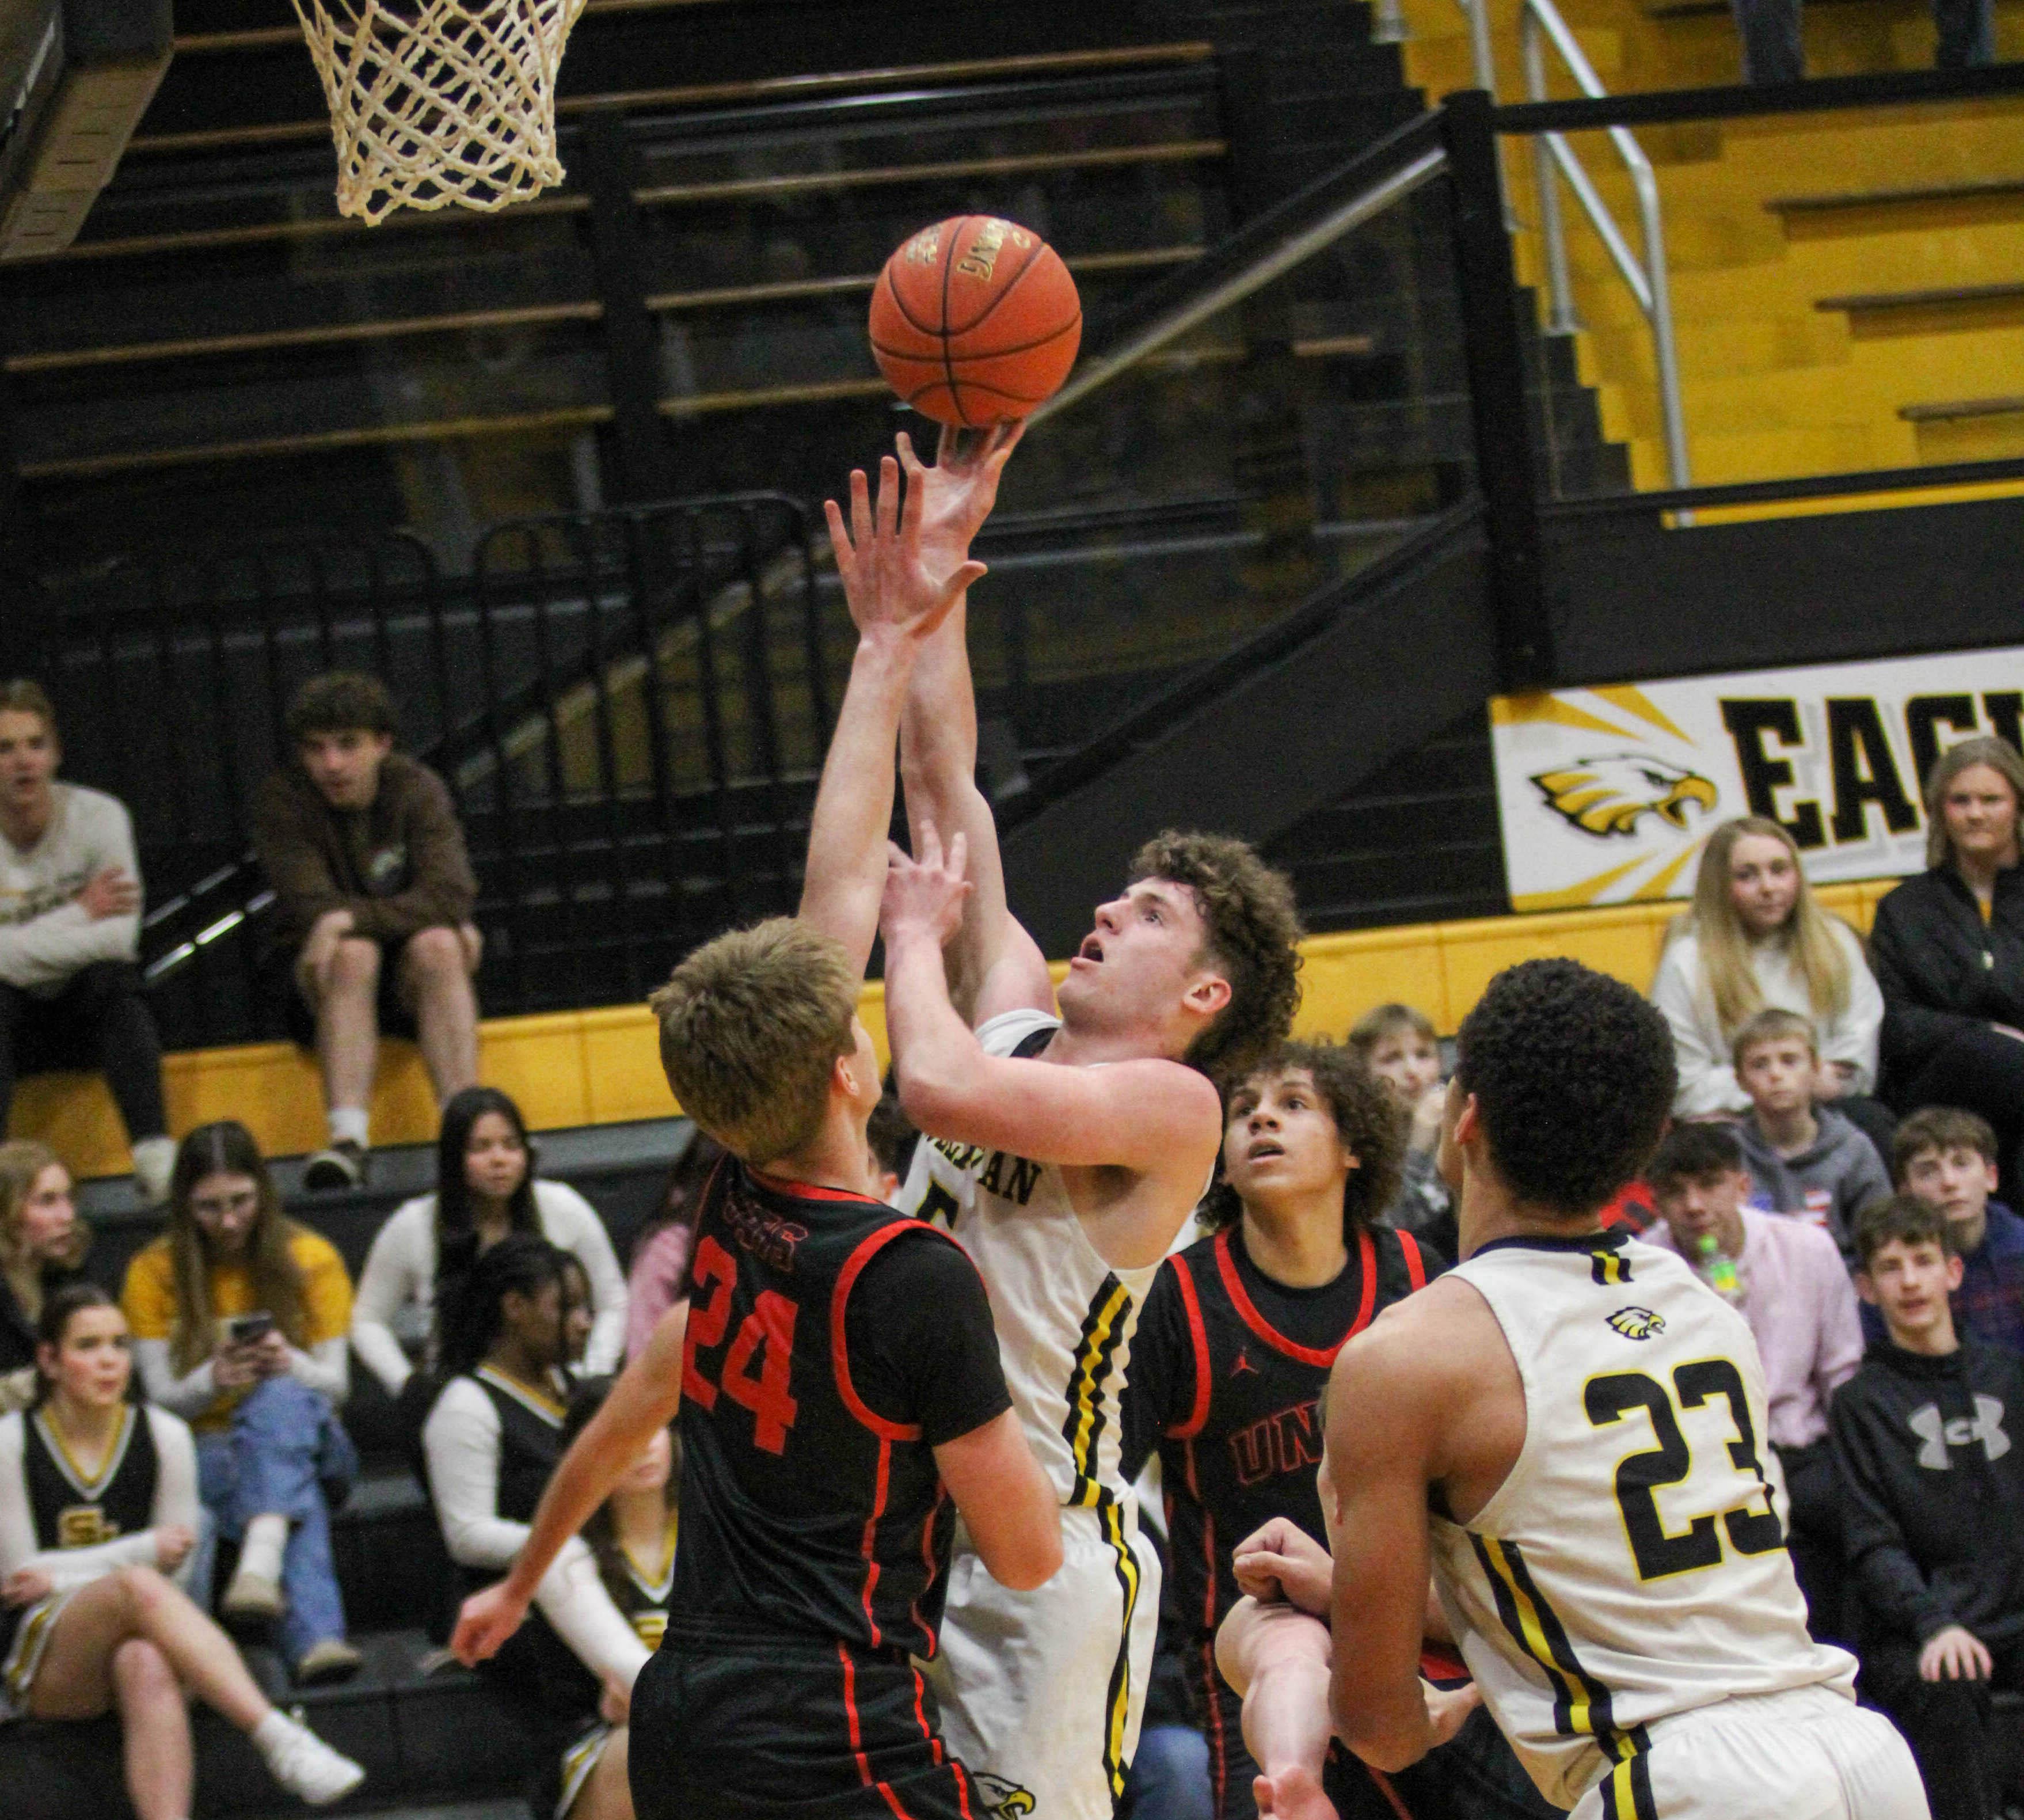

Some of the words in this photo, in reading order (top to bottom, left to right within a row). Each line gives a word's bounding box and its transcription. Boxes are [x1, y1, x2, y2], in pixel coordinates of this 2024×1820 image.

[681, 1234, 799, 1456] 24
[1228, 1400, 1325, 1486] UN
[1581, 1356, 1789, 1583] 23
